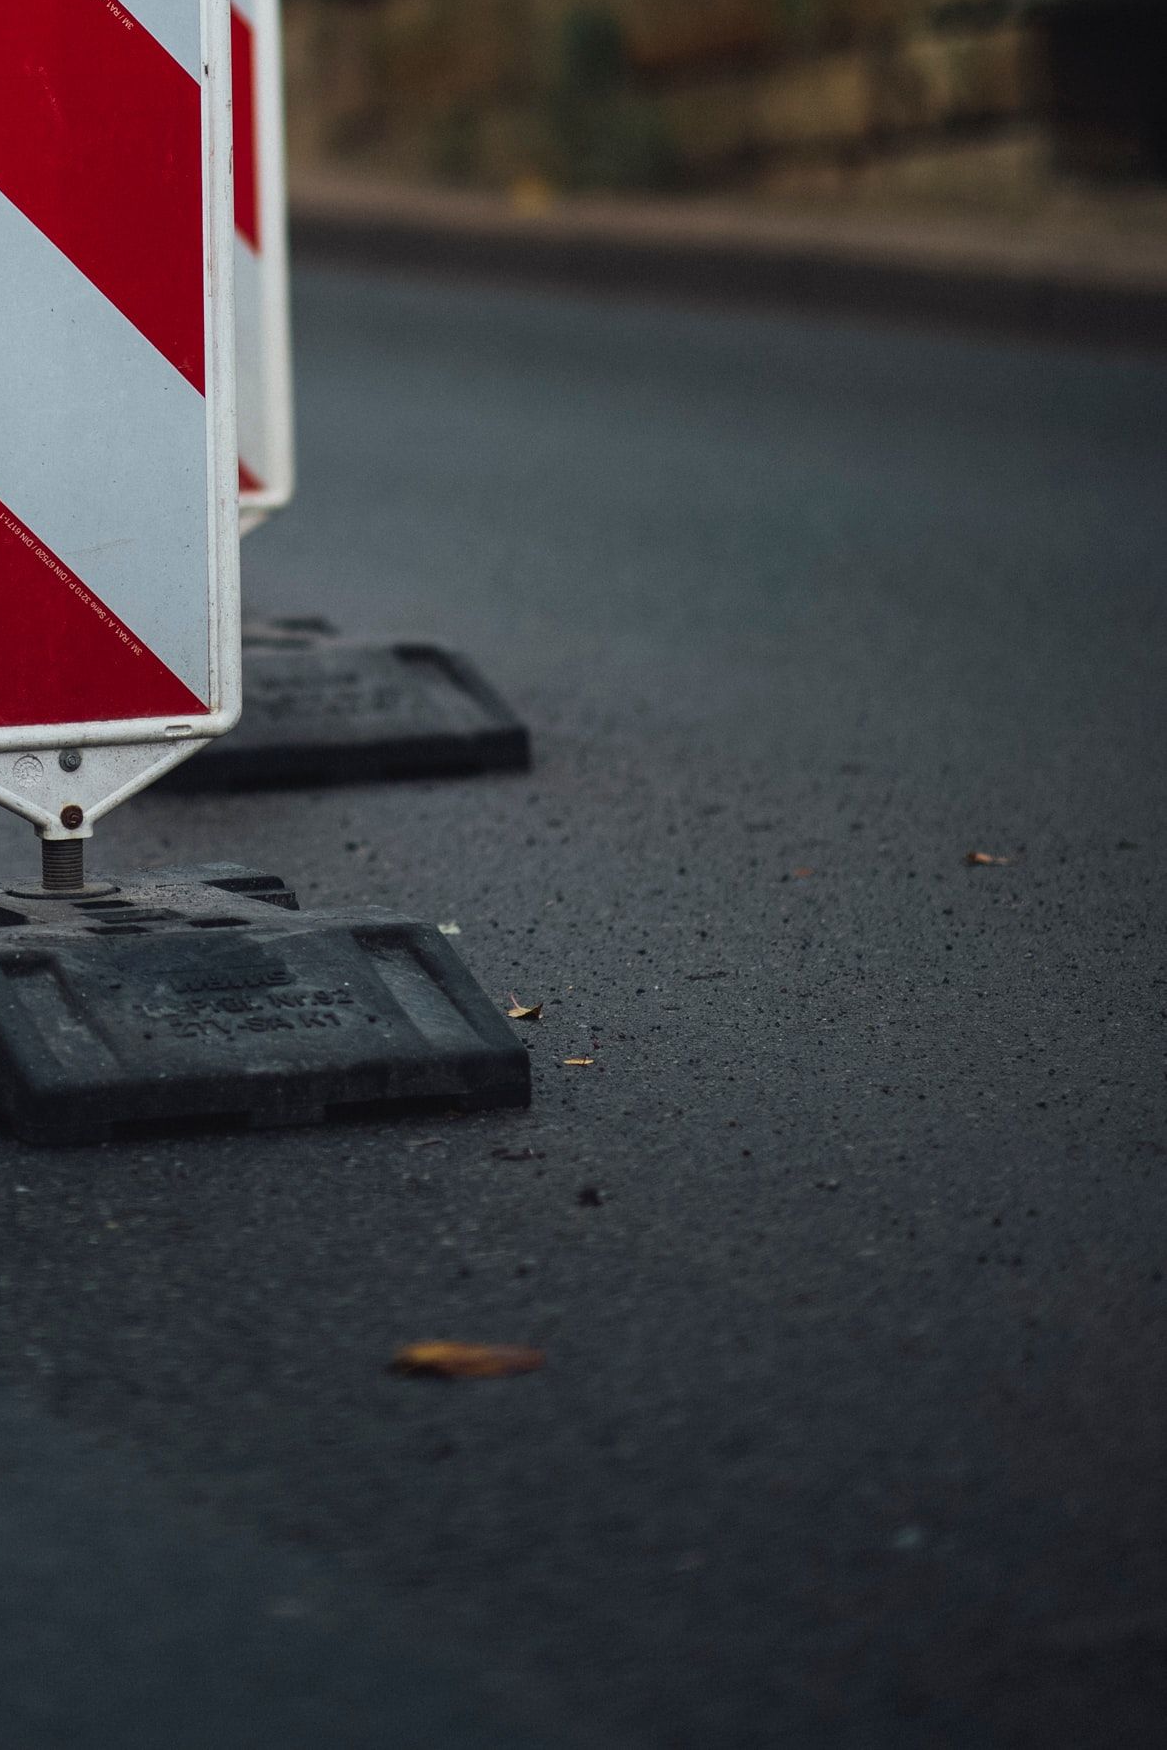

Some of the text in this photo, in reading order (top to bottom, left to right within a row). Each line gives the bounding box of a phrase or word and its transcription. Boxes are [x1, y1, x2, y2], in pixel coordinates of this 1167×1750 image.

[121, 17, 134, 31] 3M
[0, 512, 22, 535] 6171-1
[19, 532, 34, 548] DIN
[35, 548, 56, 569] 67520
[53, 566, 68, 581] DIN
[74, 586, 92, 604] 3210
[90, 601, 107, 620] Serie
[130, 643, 143, 656] 3M
